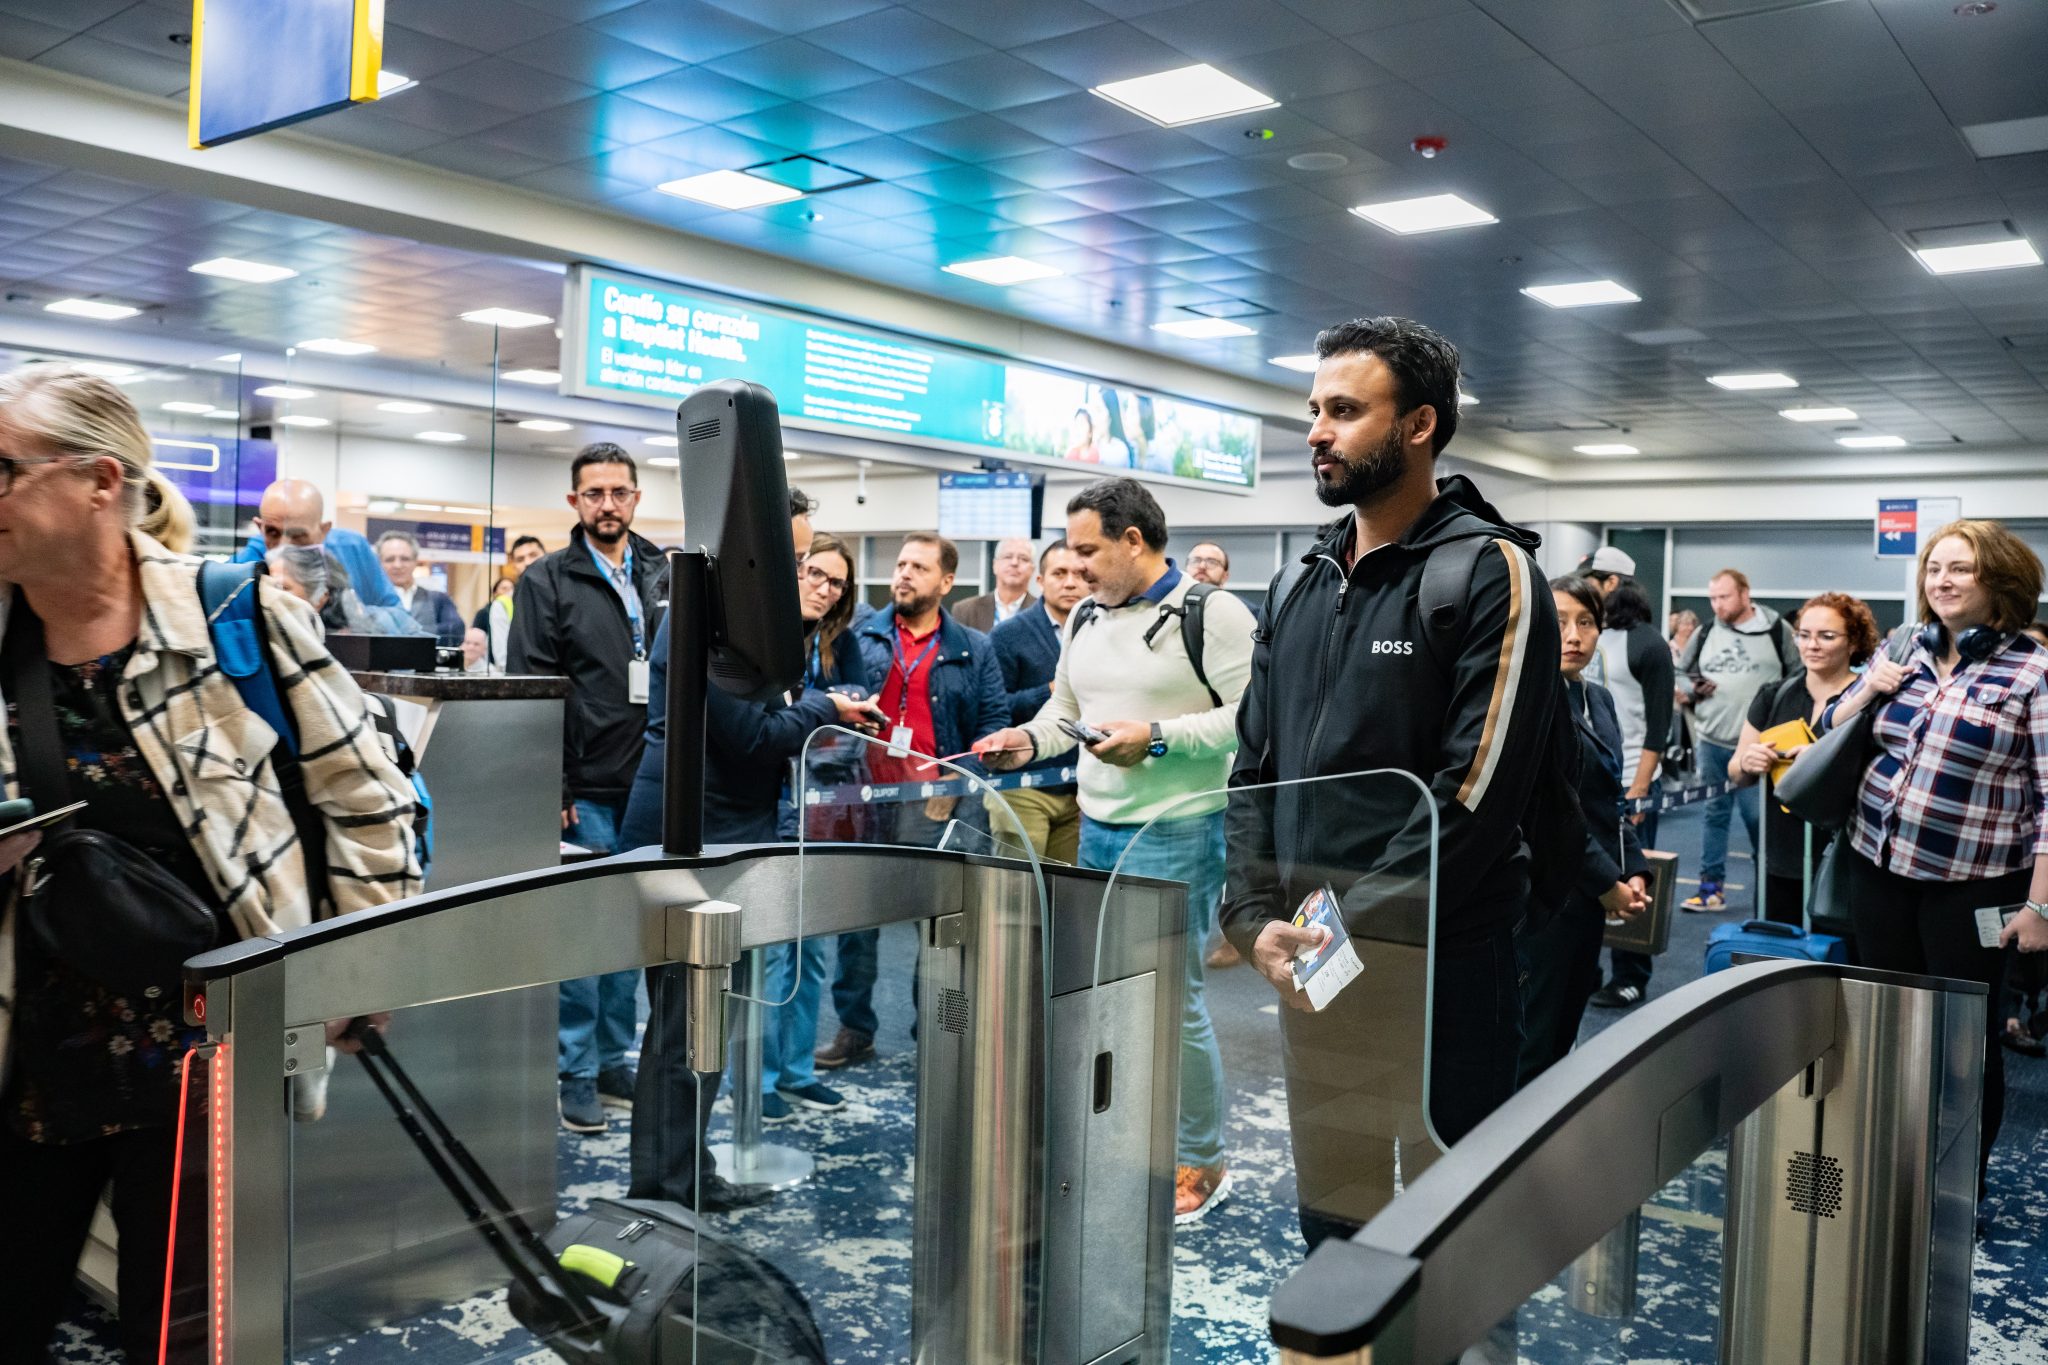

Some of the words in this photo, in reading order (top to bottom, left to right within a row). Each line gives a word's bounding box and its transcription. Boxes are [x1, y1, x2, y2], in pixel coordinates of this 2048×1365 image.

[667, 304, 689, 326] su
[603, 317, 616, 337] a
[620, 315, 685, 350] Baptist
[1371, 640, 1413, 655] BOSS
